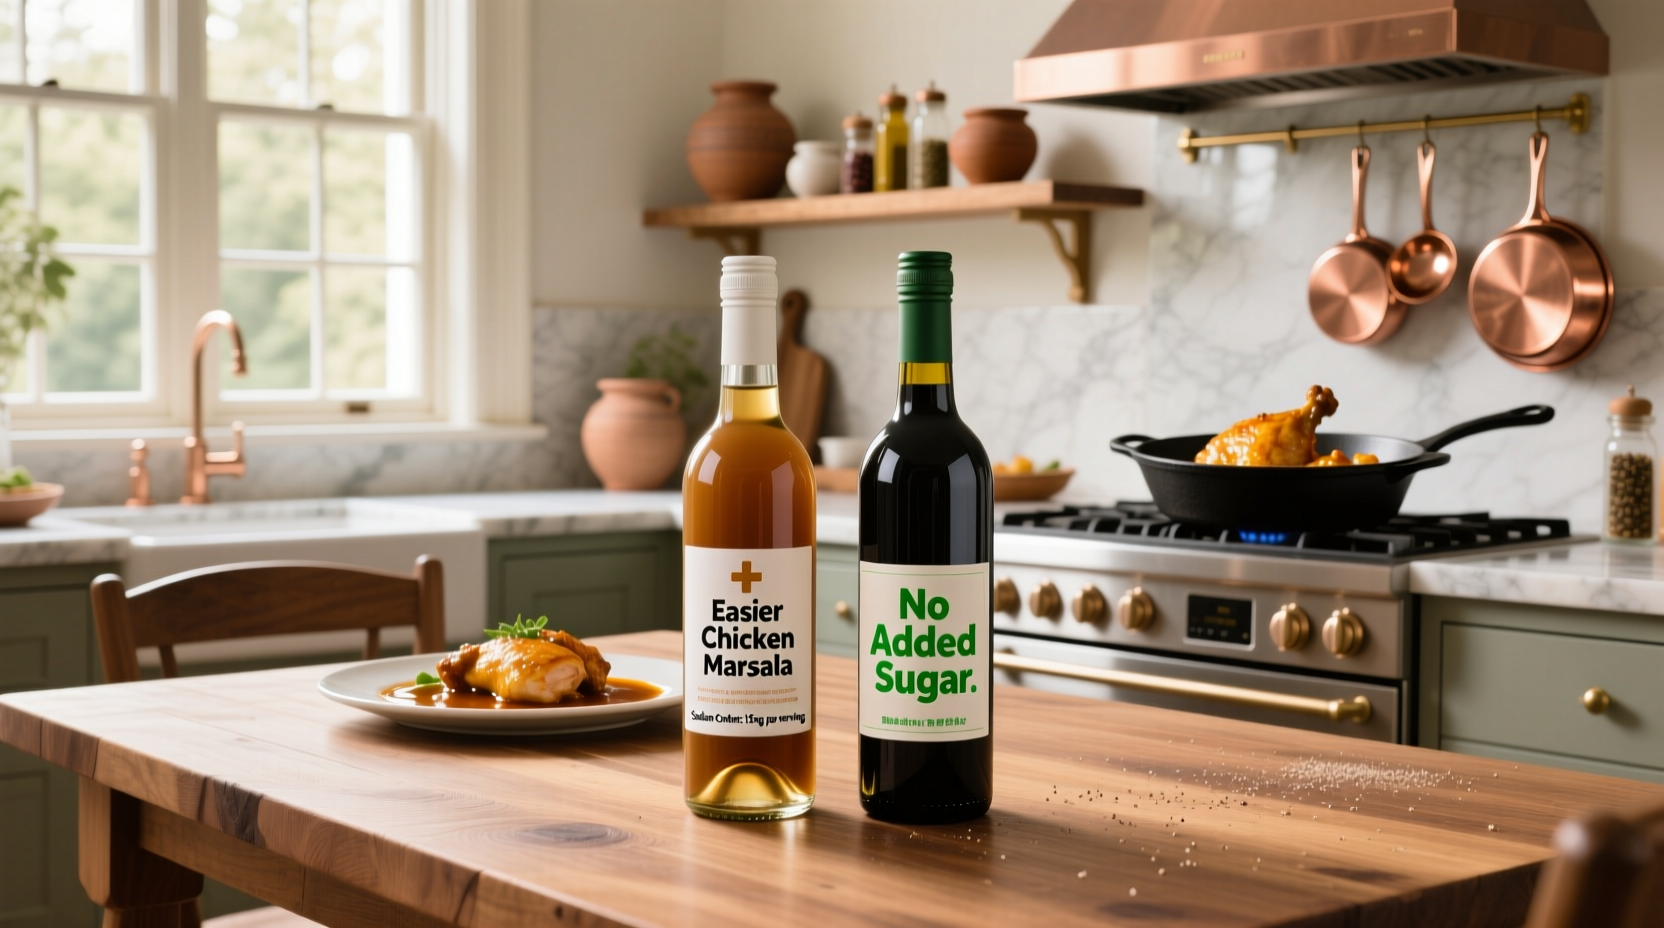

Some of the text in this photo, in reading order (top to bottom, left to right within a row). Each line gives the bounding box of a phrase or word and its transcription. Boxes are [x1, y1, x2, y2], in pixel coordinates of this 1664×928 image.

[712, 598, 784, 623] Easier
[899, 587, 950, 621] No
[701, 625, 795, 650] Chicken
[869, 623, 977, 658] Added
[703, 654, 793, 677] Marsala
[875, 660, 977, 704] Sugar.
